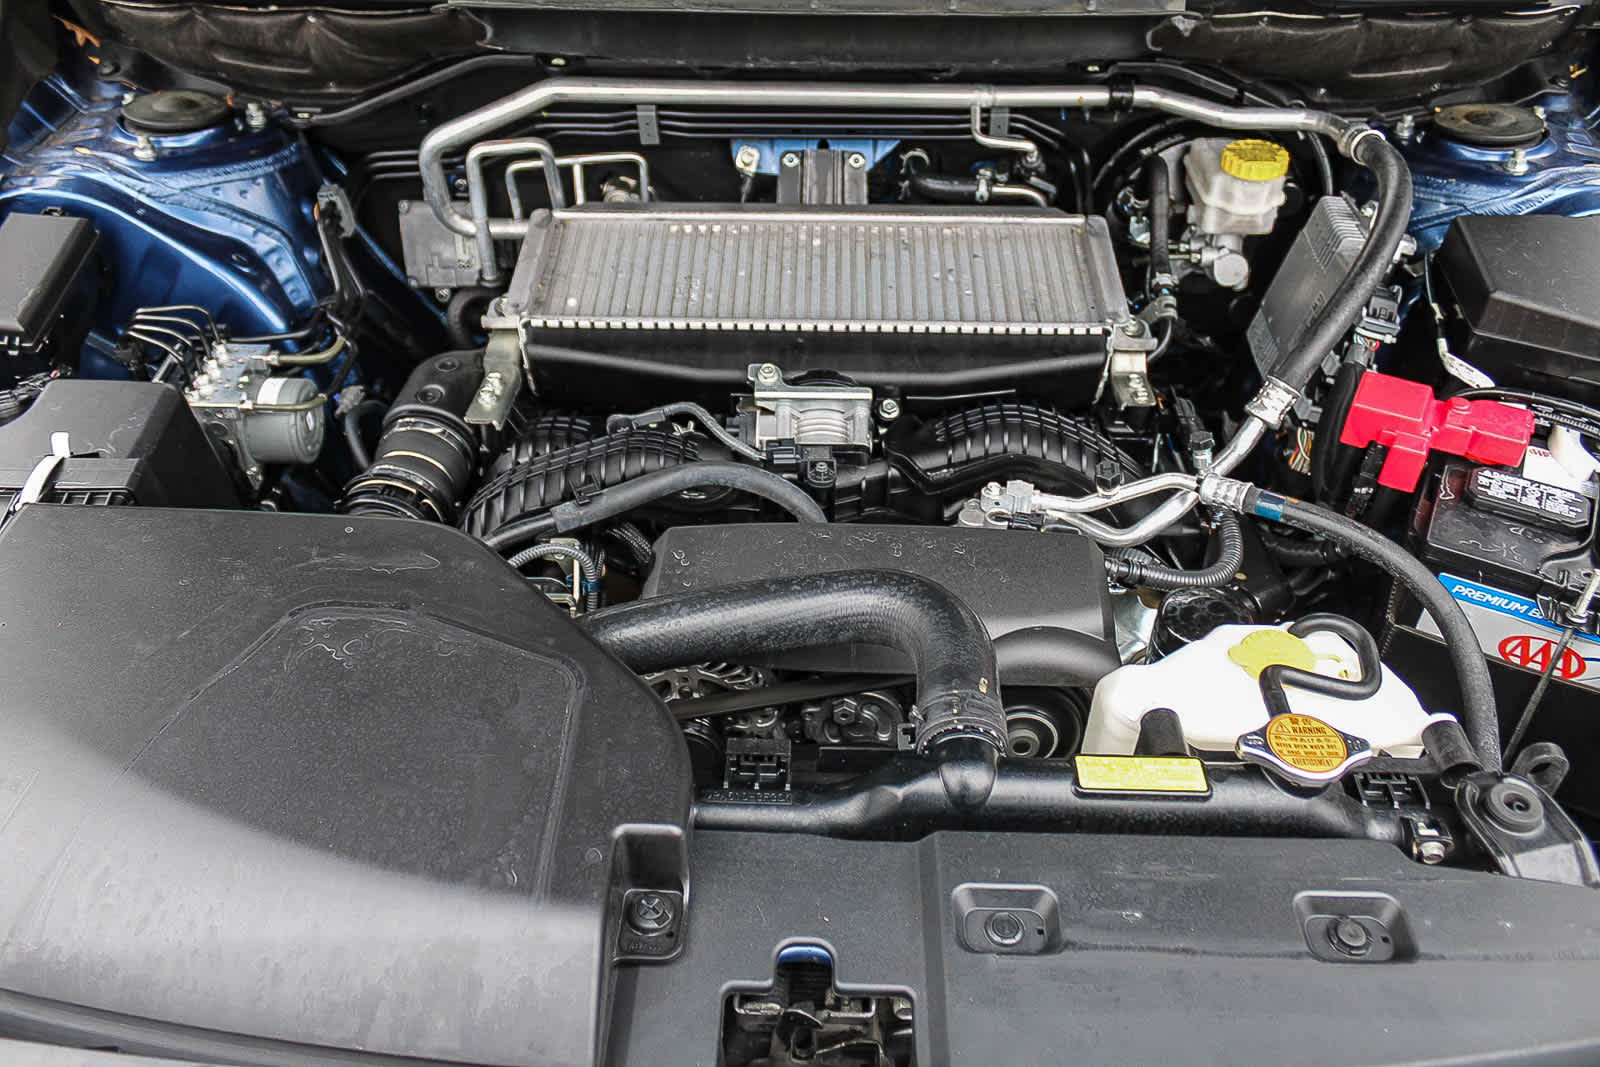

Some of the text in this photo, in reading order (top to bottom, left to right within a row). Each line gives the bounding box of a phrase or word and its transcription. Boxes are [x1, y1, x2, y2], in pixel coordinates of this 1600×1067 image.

[1452, 584, 1529, 614] PREMIUM
[1502, 637, 1579, 679] AAA
[1292, 727, 1327, 735] WARNING
